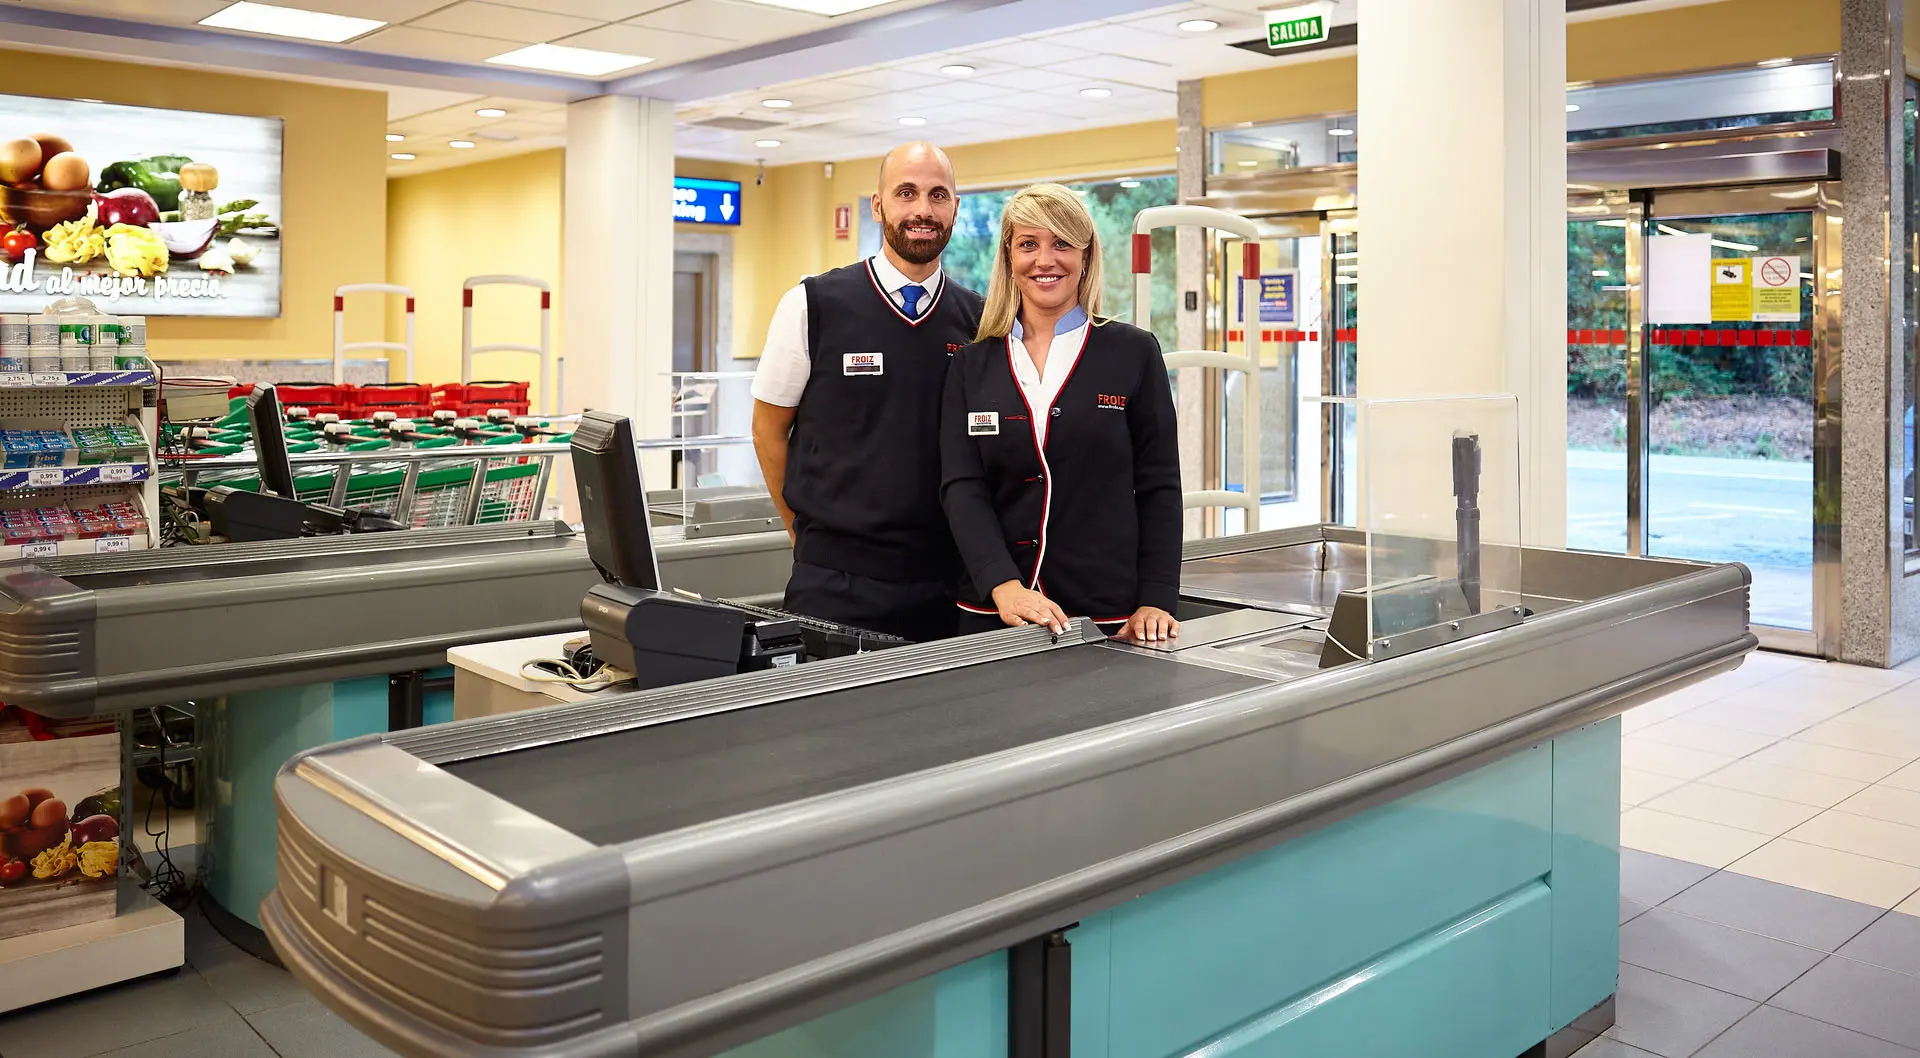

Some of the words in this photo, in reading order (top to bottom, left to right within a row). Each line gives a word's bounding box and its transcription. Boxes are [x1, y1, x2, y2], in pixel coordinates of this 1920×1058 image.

[1271, 19, 1319, 42] SALIDA
[46, 266, 74, 295] al
[80, 271, 150, 302] mejor
[851, 355, 874, 363] FROIZ
[1098, 393, 1127, 407] FROIZ
[974, 414, 992, 423] FROIZ
